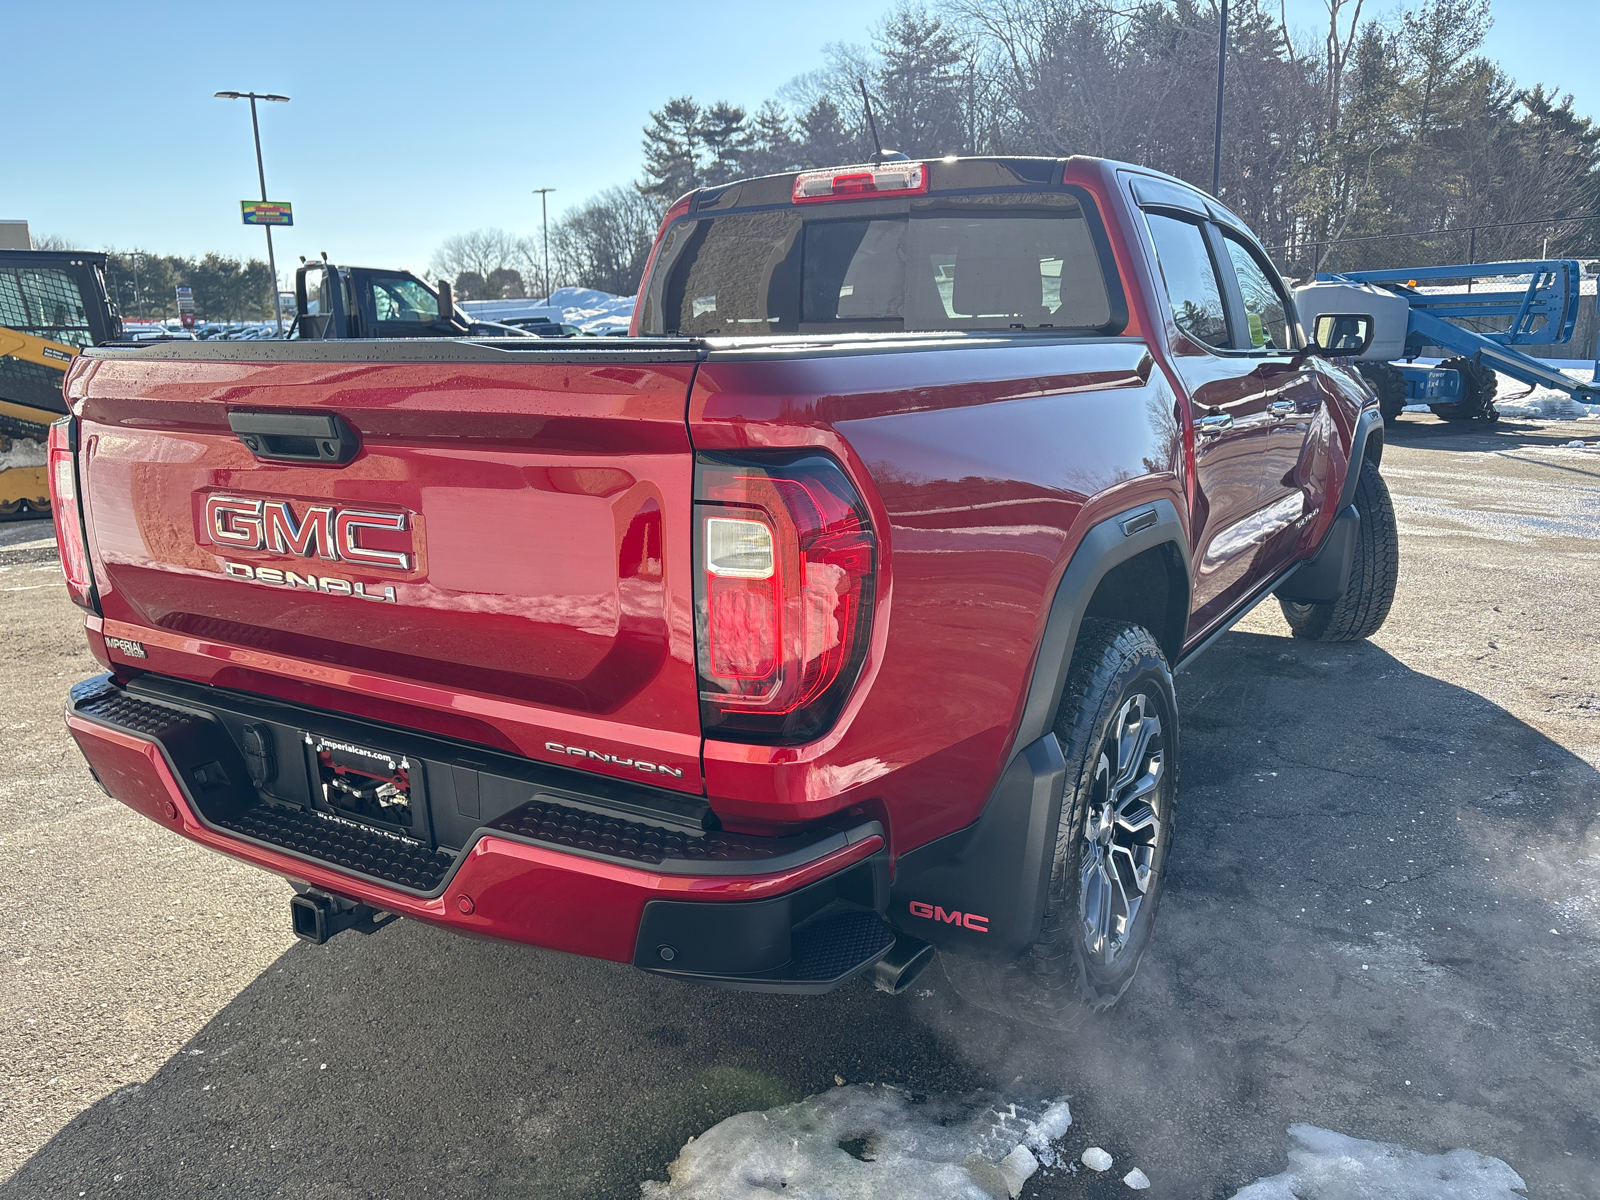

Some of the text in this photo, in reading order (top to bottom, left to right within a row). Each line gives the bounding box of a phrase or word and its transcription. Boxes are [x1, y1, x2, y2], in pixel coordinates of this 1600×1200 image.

[206, 494, 411, 570] GMC
[225, 561, 398, 603] DENALI
[105, 636, 144, 652] IMPERIAL
[320, 737, 392, 762] Imperialcars.com
[545, 742, 684, 778] CANYON
[909, 900, 990, 933] GMC
